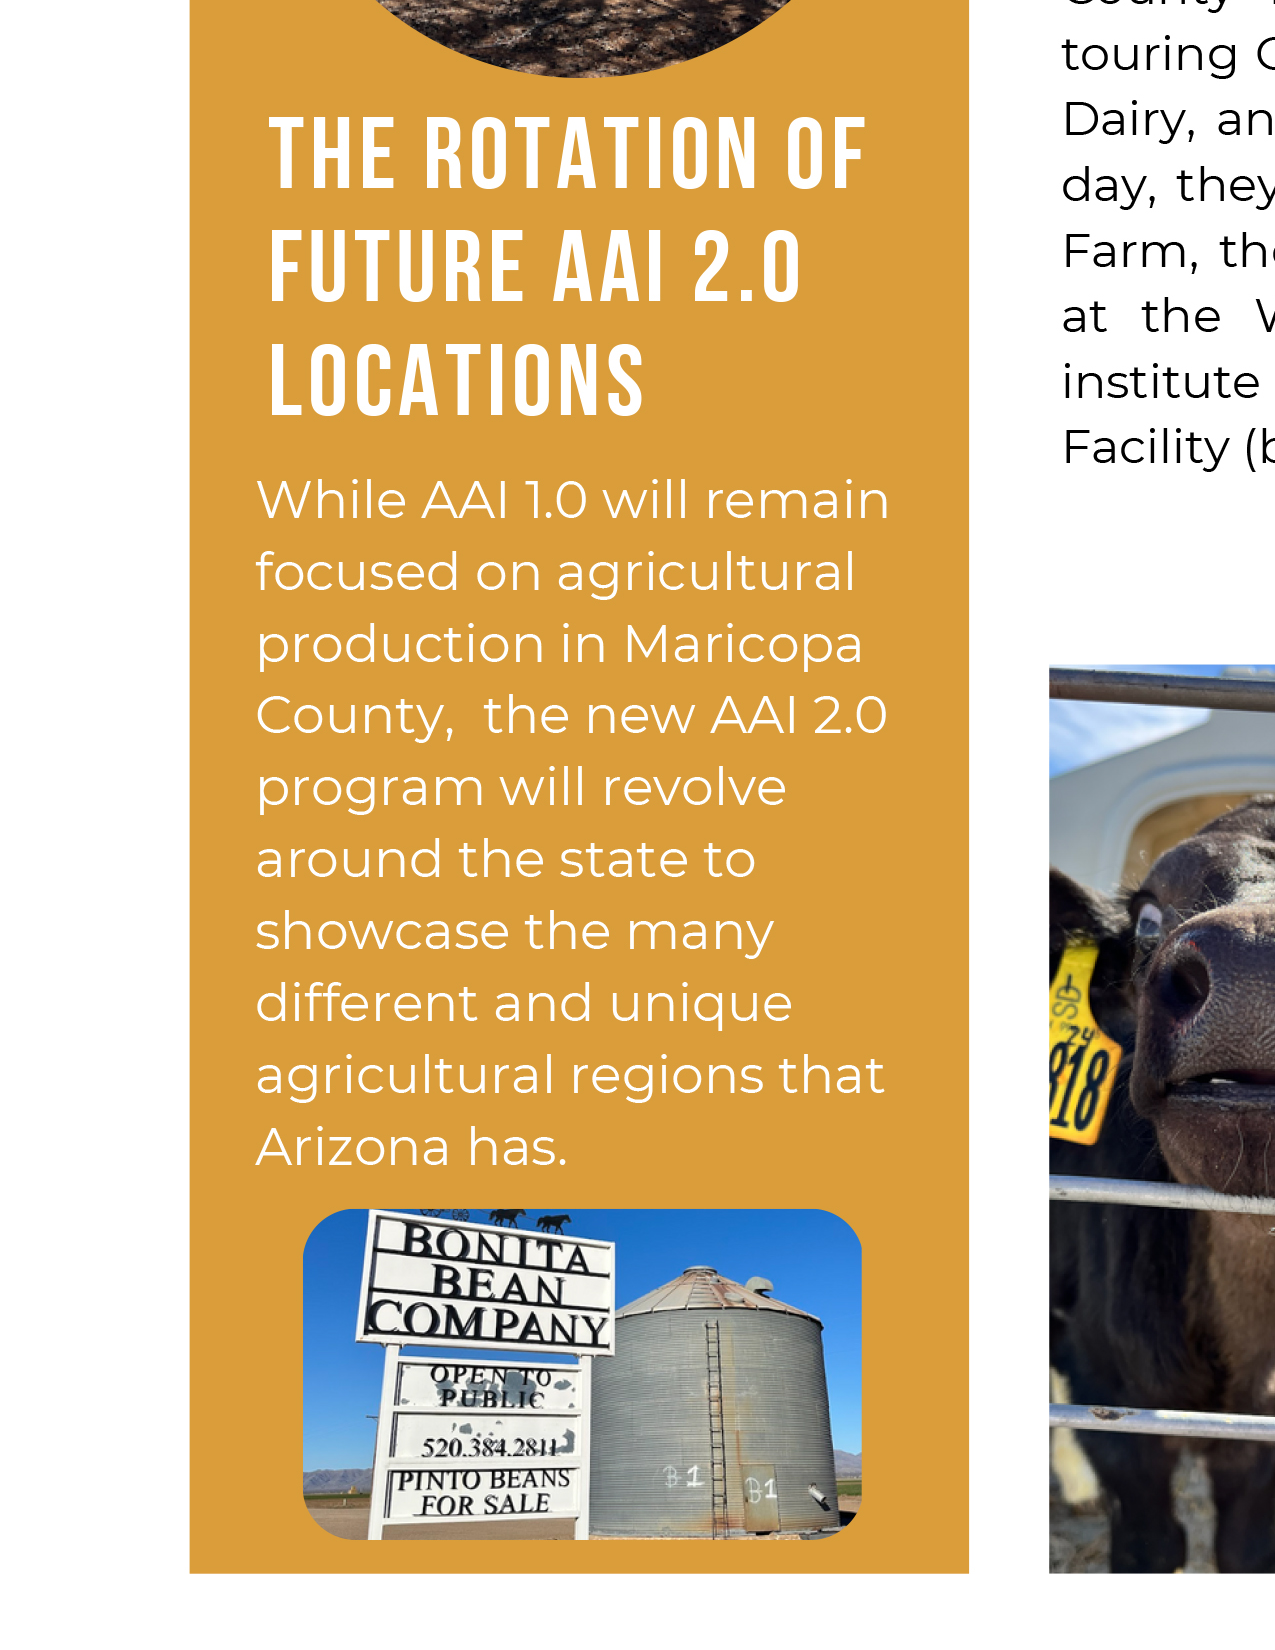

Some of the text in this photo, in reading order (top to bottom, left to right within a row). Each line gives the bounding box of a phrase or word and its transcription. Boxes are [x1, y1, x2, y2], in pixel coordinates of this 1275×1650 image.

[1062, 35, 1235, 79] touring
[269, 117, 864, 189] THE ROTATION OF
[272, 230, 798, 302] FUTURE AAI 2.0
[272, 344, 641, 416] LOCATIONS
[1067, 428, 1230, 472] Facility
[257, 479, 886, 518] While AAI 1.0 will remain
[401, 1222, 590, 1273] BONITA
[431, 1263, 567, 1305] BEAN
[368, 1298, 608, 1346] COMPANY
[430, 1364, 552, 1387] OPEN TO
[441, 1388, 545, 1409] PUBLIC
[421, 1437, 558, 1457] 520.384.2811
[398, 1468, 570, 1491] PINTO BEANS
[421, 1493, 551, 1516] FOR SALE
